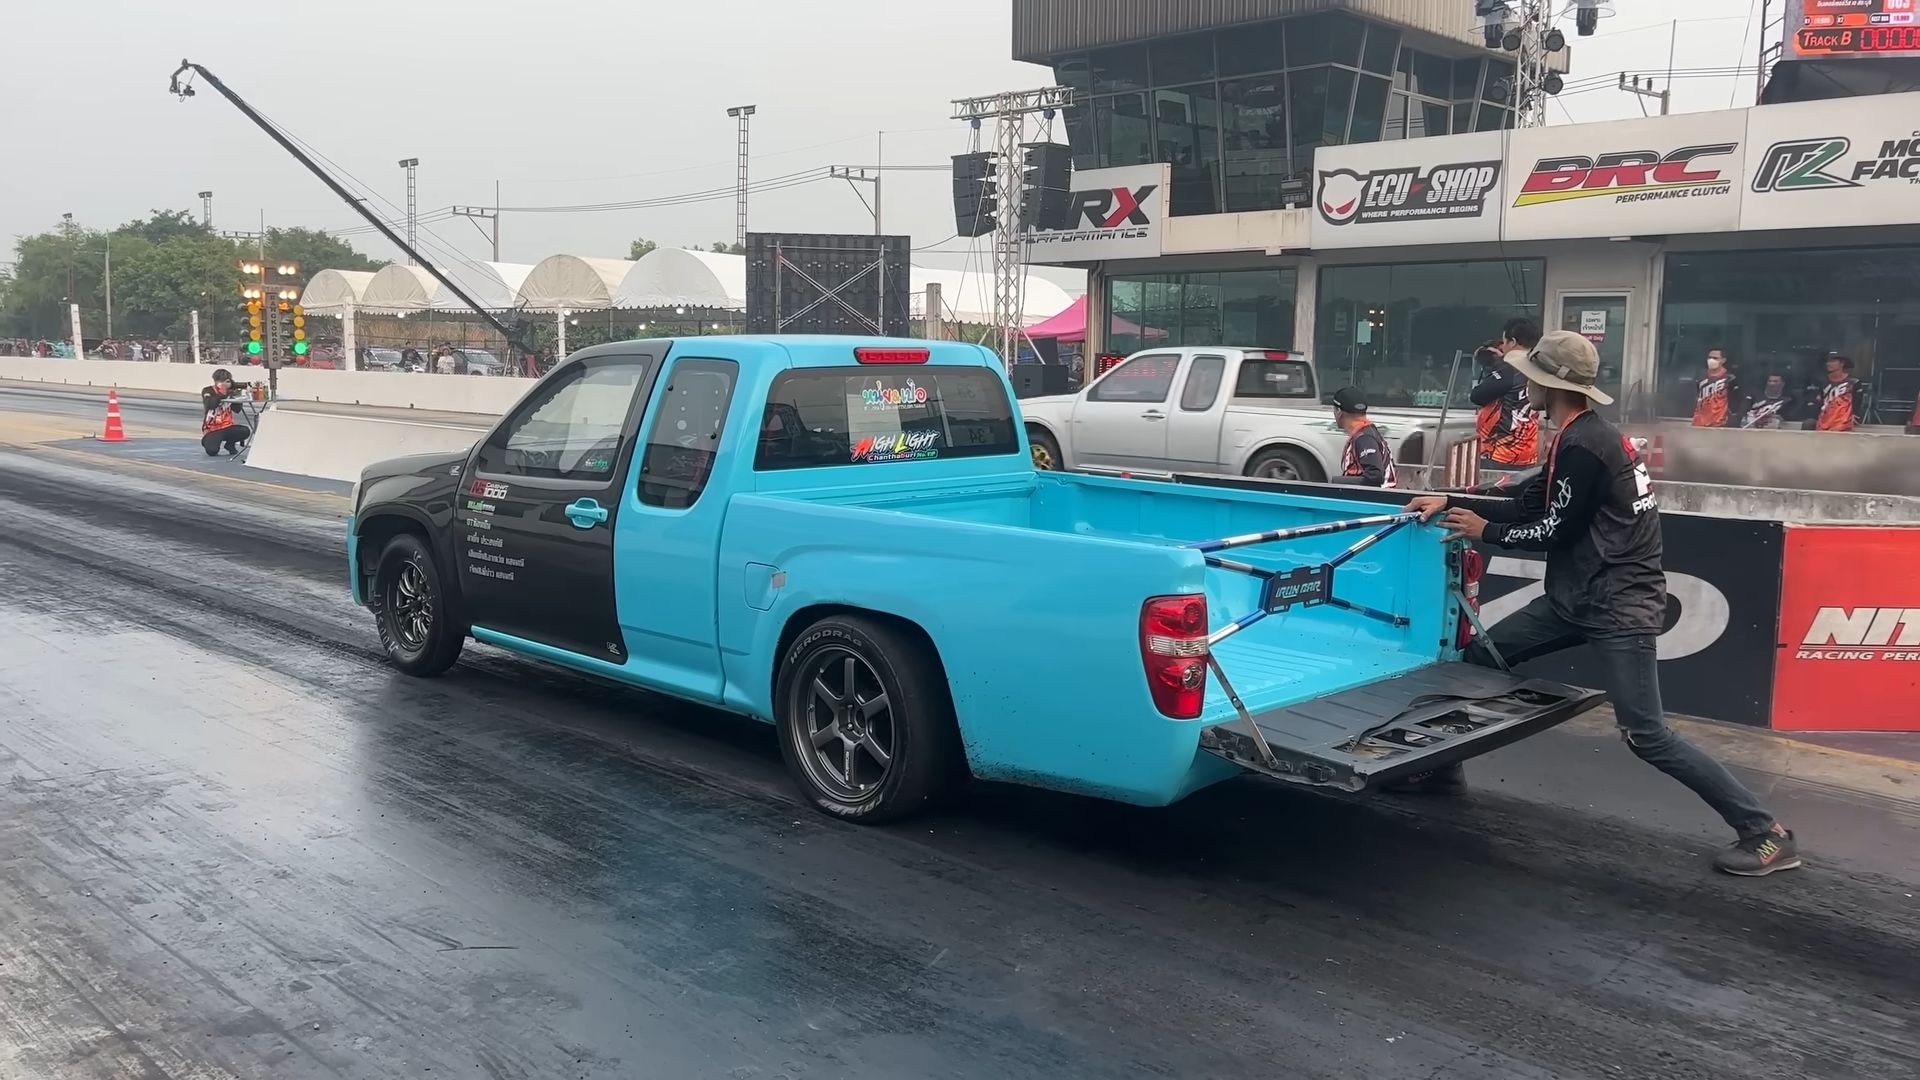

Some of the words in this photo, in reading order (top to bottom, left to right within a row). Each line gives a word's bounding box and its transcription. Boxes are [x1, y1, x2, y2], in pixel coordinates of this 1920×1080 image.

[1804, 32, 1839, 46] TRACK
[1841, 31, 1852, 46] B
[1520, 142, 1739, 193] BRC
[1364, 172, 1413, 208] ECU
[1426, 166, 1495, 203] SHOP
[1615, 189, 1689, 205] PERFORMANCE
[1690, 185, 1730, 199] CLUTCH
[1390, 207, 1447, 217] PERFORMANCE
[1449, 205, 1479, 213] BEGINS
[790, 629, 863, 664] HERODRAG
[1795, 650, 1875, 661] RACING
